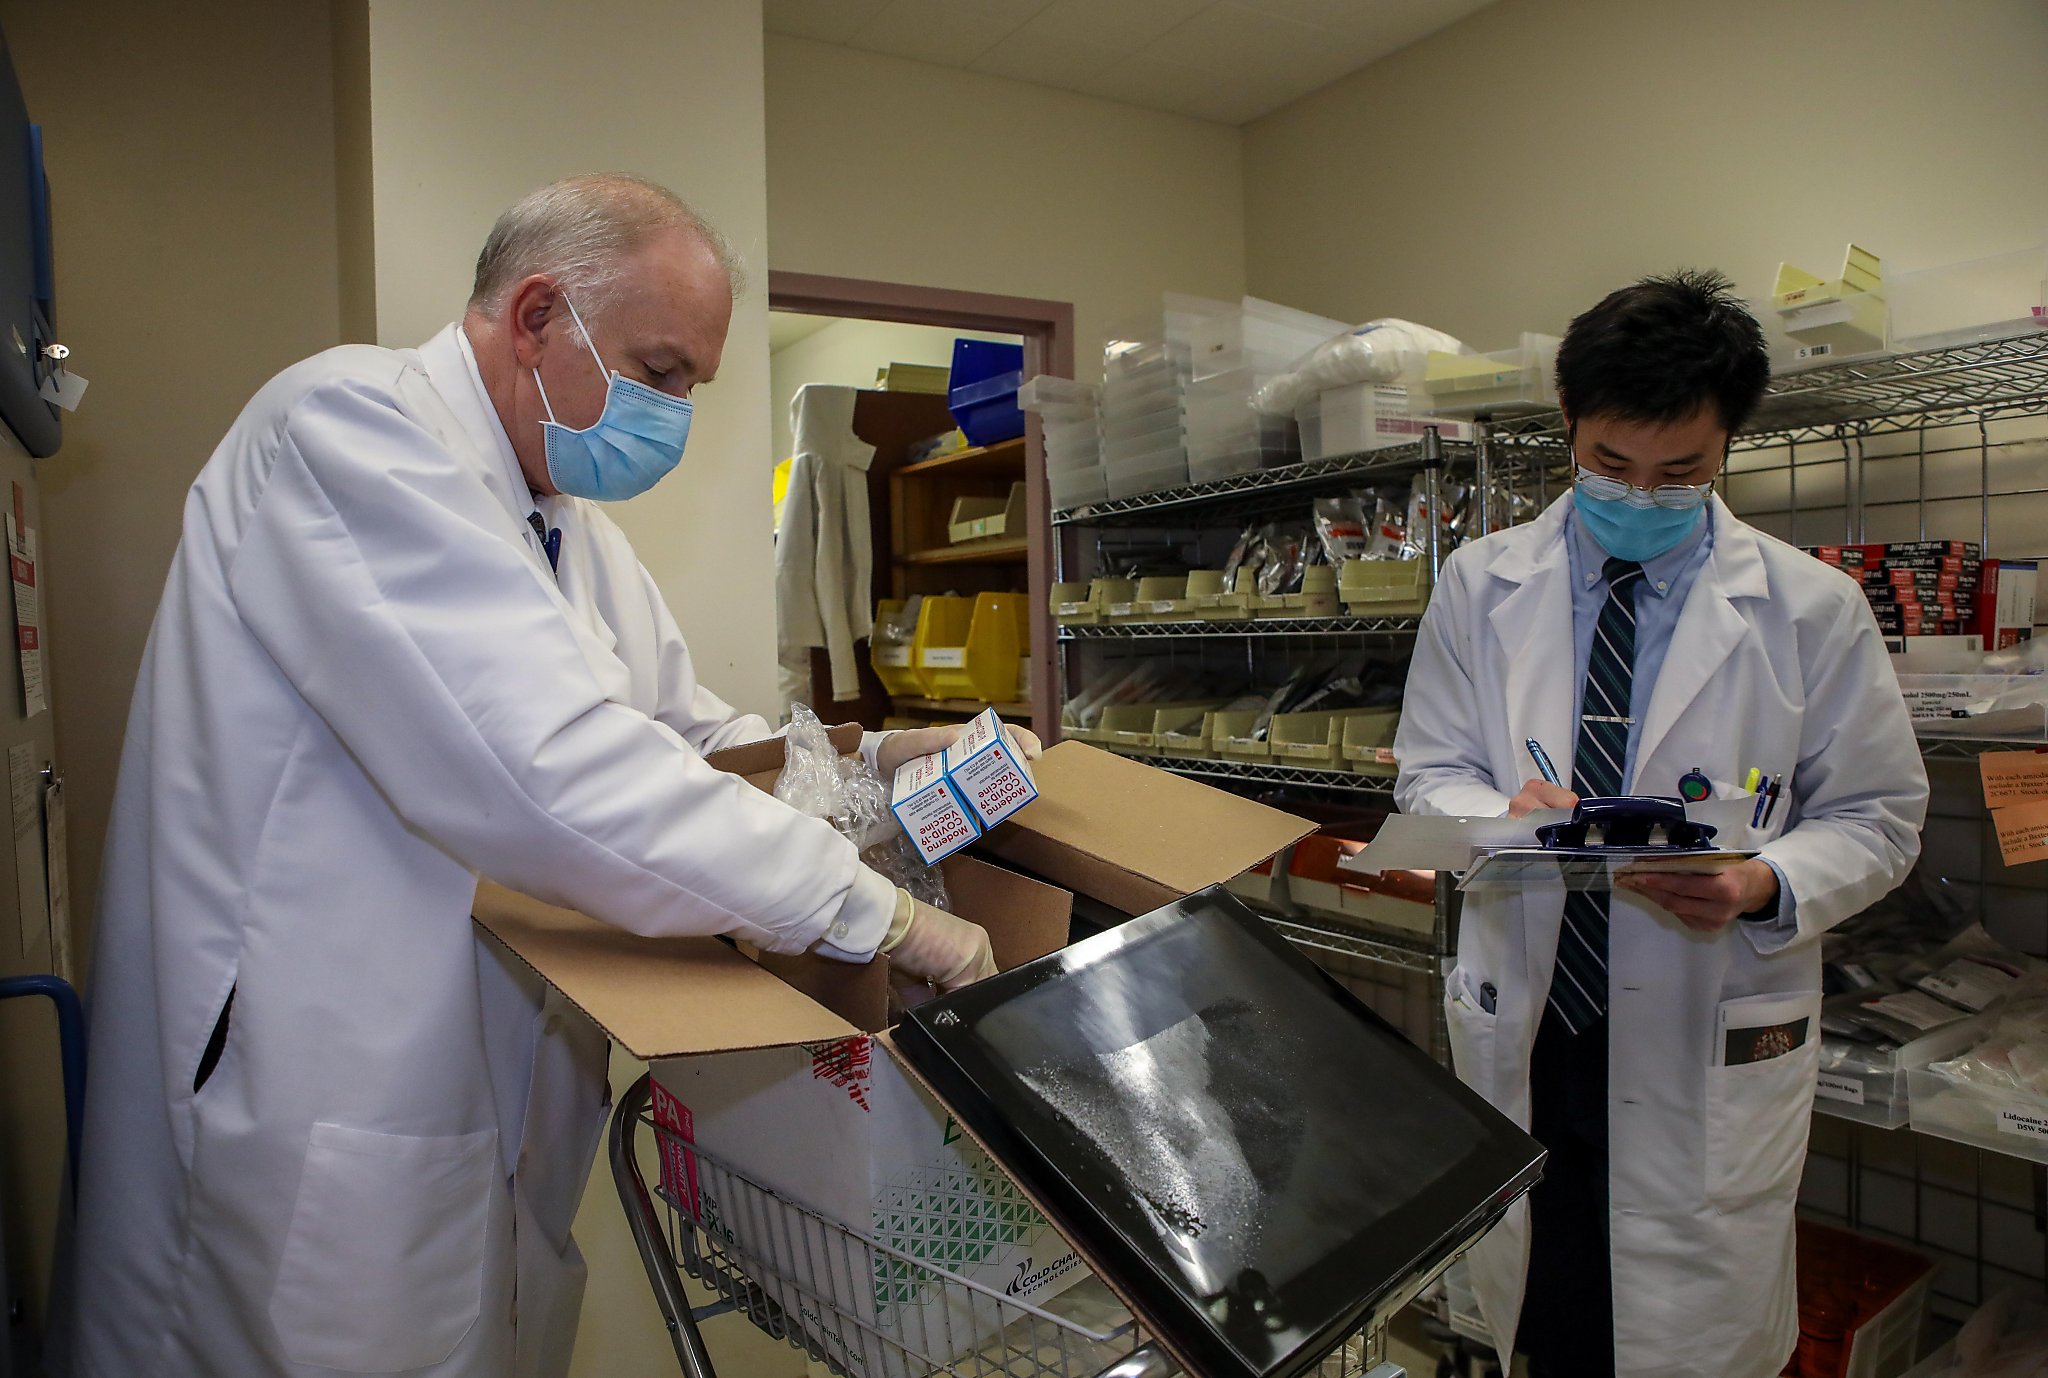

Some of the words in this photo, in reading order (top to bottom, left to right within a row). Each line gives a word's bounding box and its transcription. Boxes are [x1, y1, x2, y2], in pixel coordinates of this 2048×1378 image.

[977, 770, 1015, 799] Vaccine
[979, 777, 1021, 810] COVID-19
[986, 785, 1027, 816] Moderna
[919, 809, 959, 835] Vaccine
[919, 816, 964, 846] COVID-19
[925, 824, 969, 854] Moderna
[2003, 1112, 2042, 1126] Lidocaine
[1022, 1266, 1050, 1288] COLD
[1023, 1260, 1082, 1297] TECHNOLOGIES
